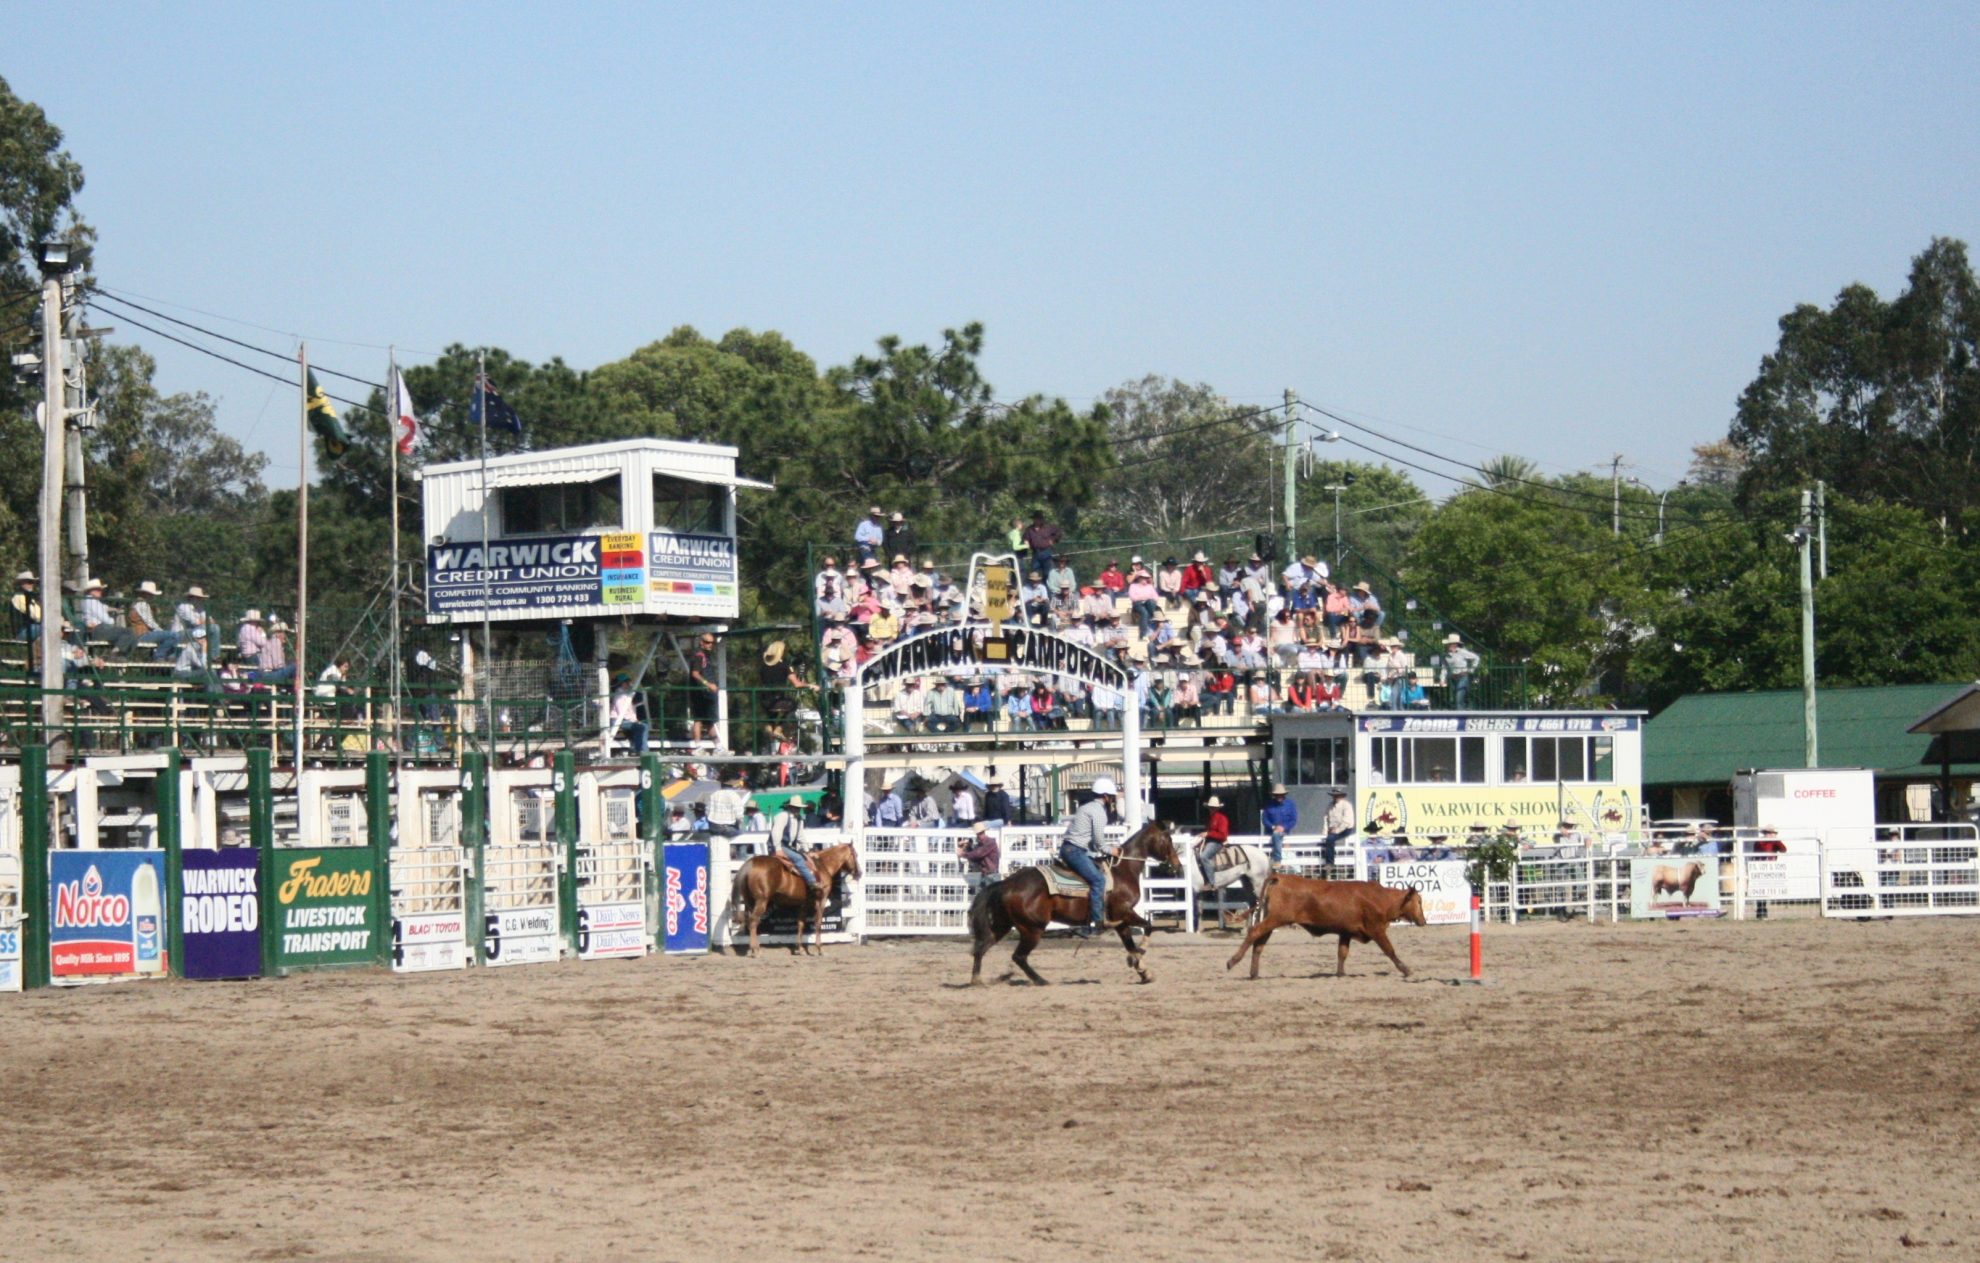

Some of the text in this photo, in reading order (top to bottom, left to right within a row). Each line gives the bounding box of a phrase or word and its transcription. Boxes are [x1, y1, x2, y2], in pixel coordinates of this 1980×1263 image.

[434, 541, 597, 570] WARWICK
[653, 536, 730, 558] WARWICK
[653, 554, 731, 568] CREDIT UNION
[434, 565, 598, 584] CREDIT UNION
[496, 585, 553, 596] COMMUNITY
[556, 583, 598, 592] BANKING
[536, 596, 556, 604] 1300
[574, 594, 589, 602] 433
[880, 627, 1124, 691] WARWICK CAMPDRAFT
[1465, 718, 1518, 732] SIGNS
[1524, 719, 1538, 730] 07
[1566, 719, 1592, 730] 1712
[462, 772, 473, 791] 4
[554, 772, 565, 792] 5
[641, 770, 652, 789] 6
[1794, 789, 1836, 798] COFFEE
[1421, 801, 1576, 816] WARWICK SHOW &
[279, 856, 372, 904] Frasers
[1386, 864, 1438, 878] BLACK
[182, 868, 258, 894] WARWICK
[1386, 880, 1442, 892] TOYOTA
[56, 880, 130, 927] Norco
[666, 866, 682, 936] Norco
[694, 866, 708, 934] Norco
[182, 894, 258, 934] RODEO
[286, 906, 366, 928] LIVESTOCK
[620, 907, 640, 921] News
[435, 922, 460, 934] TOYOTA
[506, 918, 518, 932] C.G.
[284, 930, 371, 954] TRANSPORT
[485, 916, 500, 960] 5
[620, 932, 640, 946] News
[56, 954, 80, 966] Quality
[96, 952, 112, 964] Since
[114, 952, 130, 962] 1895
